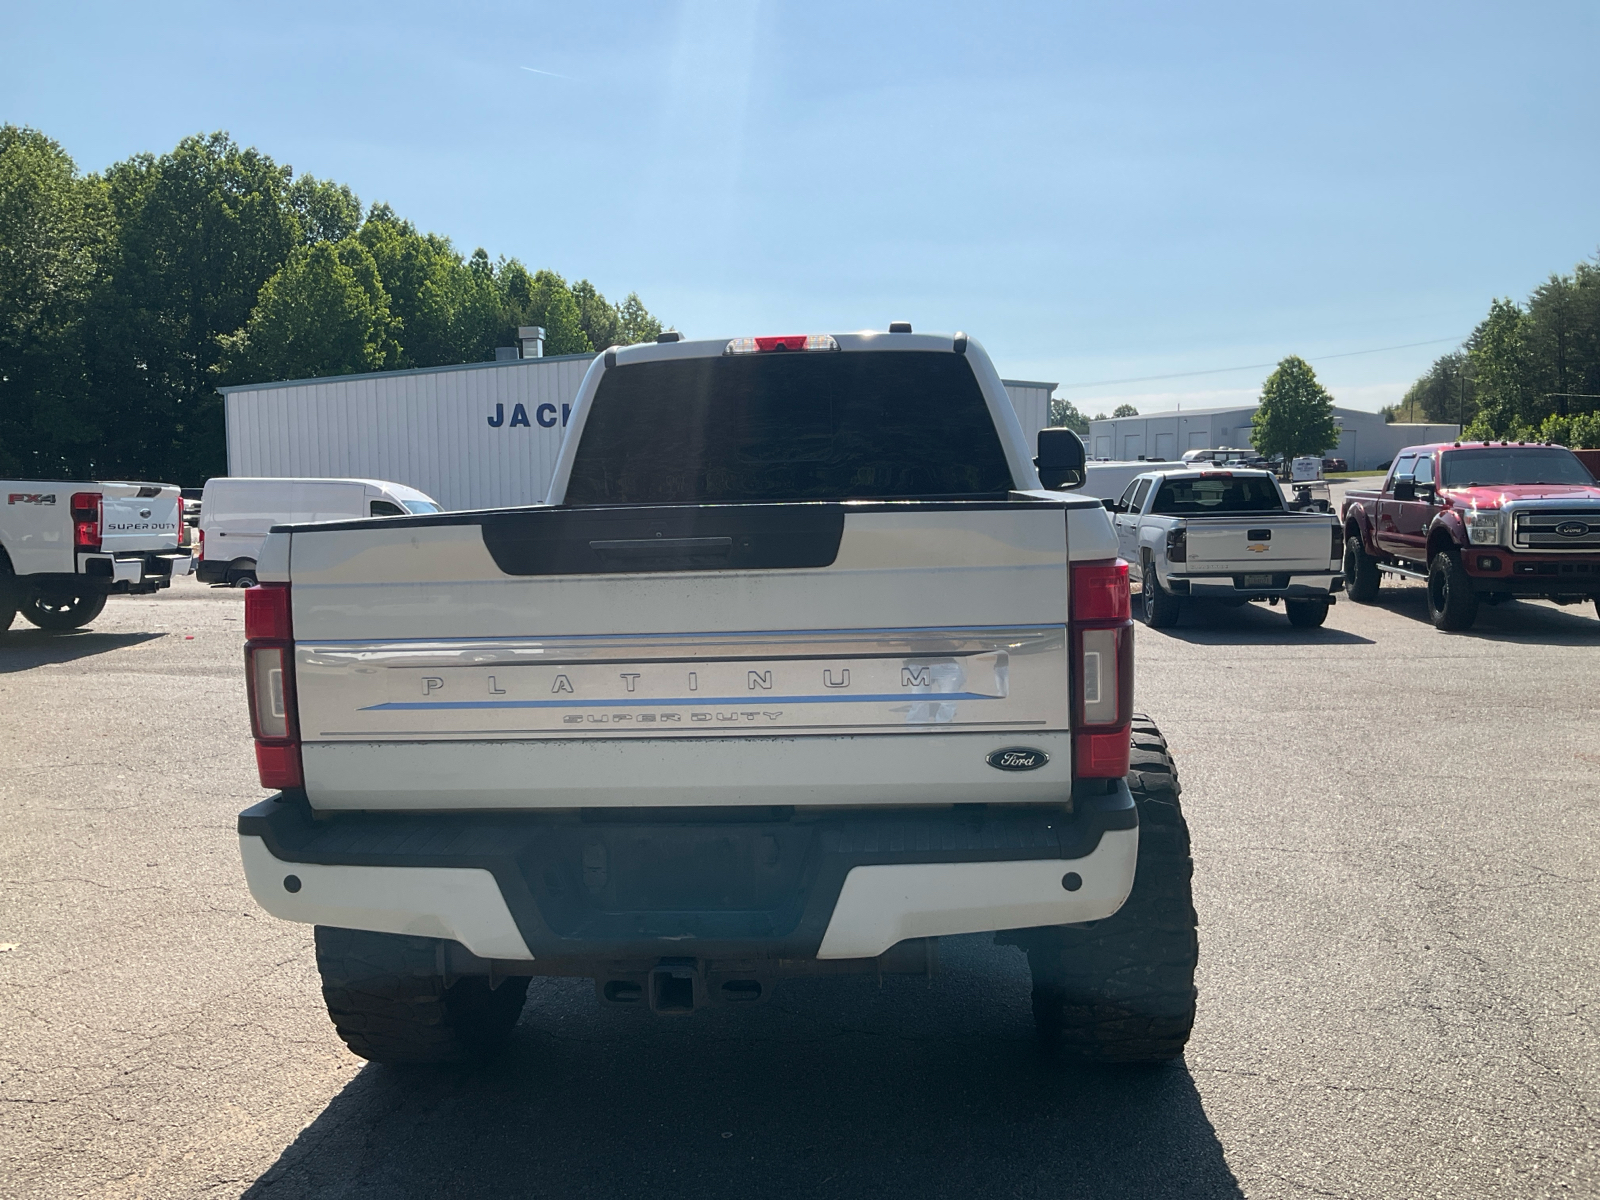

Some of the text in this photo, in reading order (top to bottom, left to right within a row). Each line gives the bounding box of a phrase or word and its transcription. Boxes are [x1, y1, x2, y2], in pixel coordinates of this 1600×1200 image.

[7, 493, 56, 505] FX4
[151, 522, 177, 530] DUTY
[420, 666, 931, 696] PLATINUM
[563, 711, 784, 724] SUPER DUTY
[1000, 752, 1035, 766] Ford
